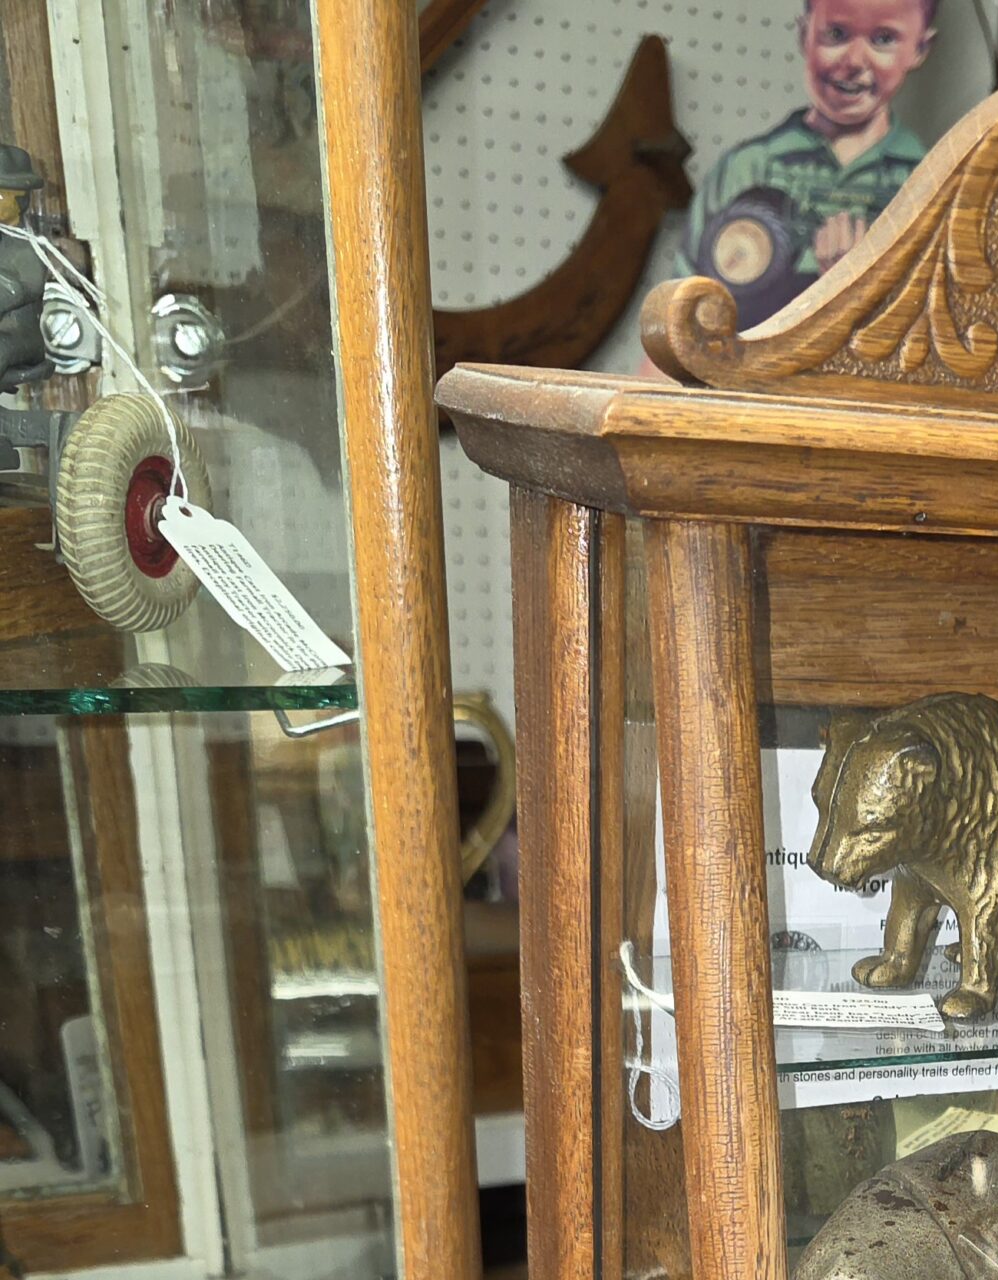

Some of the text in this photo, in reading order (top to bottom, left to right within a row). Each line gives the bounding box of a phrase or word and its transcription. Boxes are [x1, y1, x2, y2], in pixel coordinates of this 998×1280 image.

[793, 1071, 830, 1082] stones
[834, 1070, 855, 1081] and
[859, 1067, 918, 1081] personality
[922, 1066, 948, 1077] traits
[952, 1065, 991, 1076] defined
